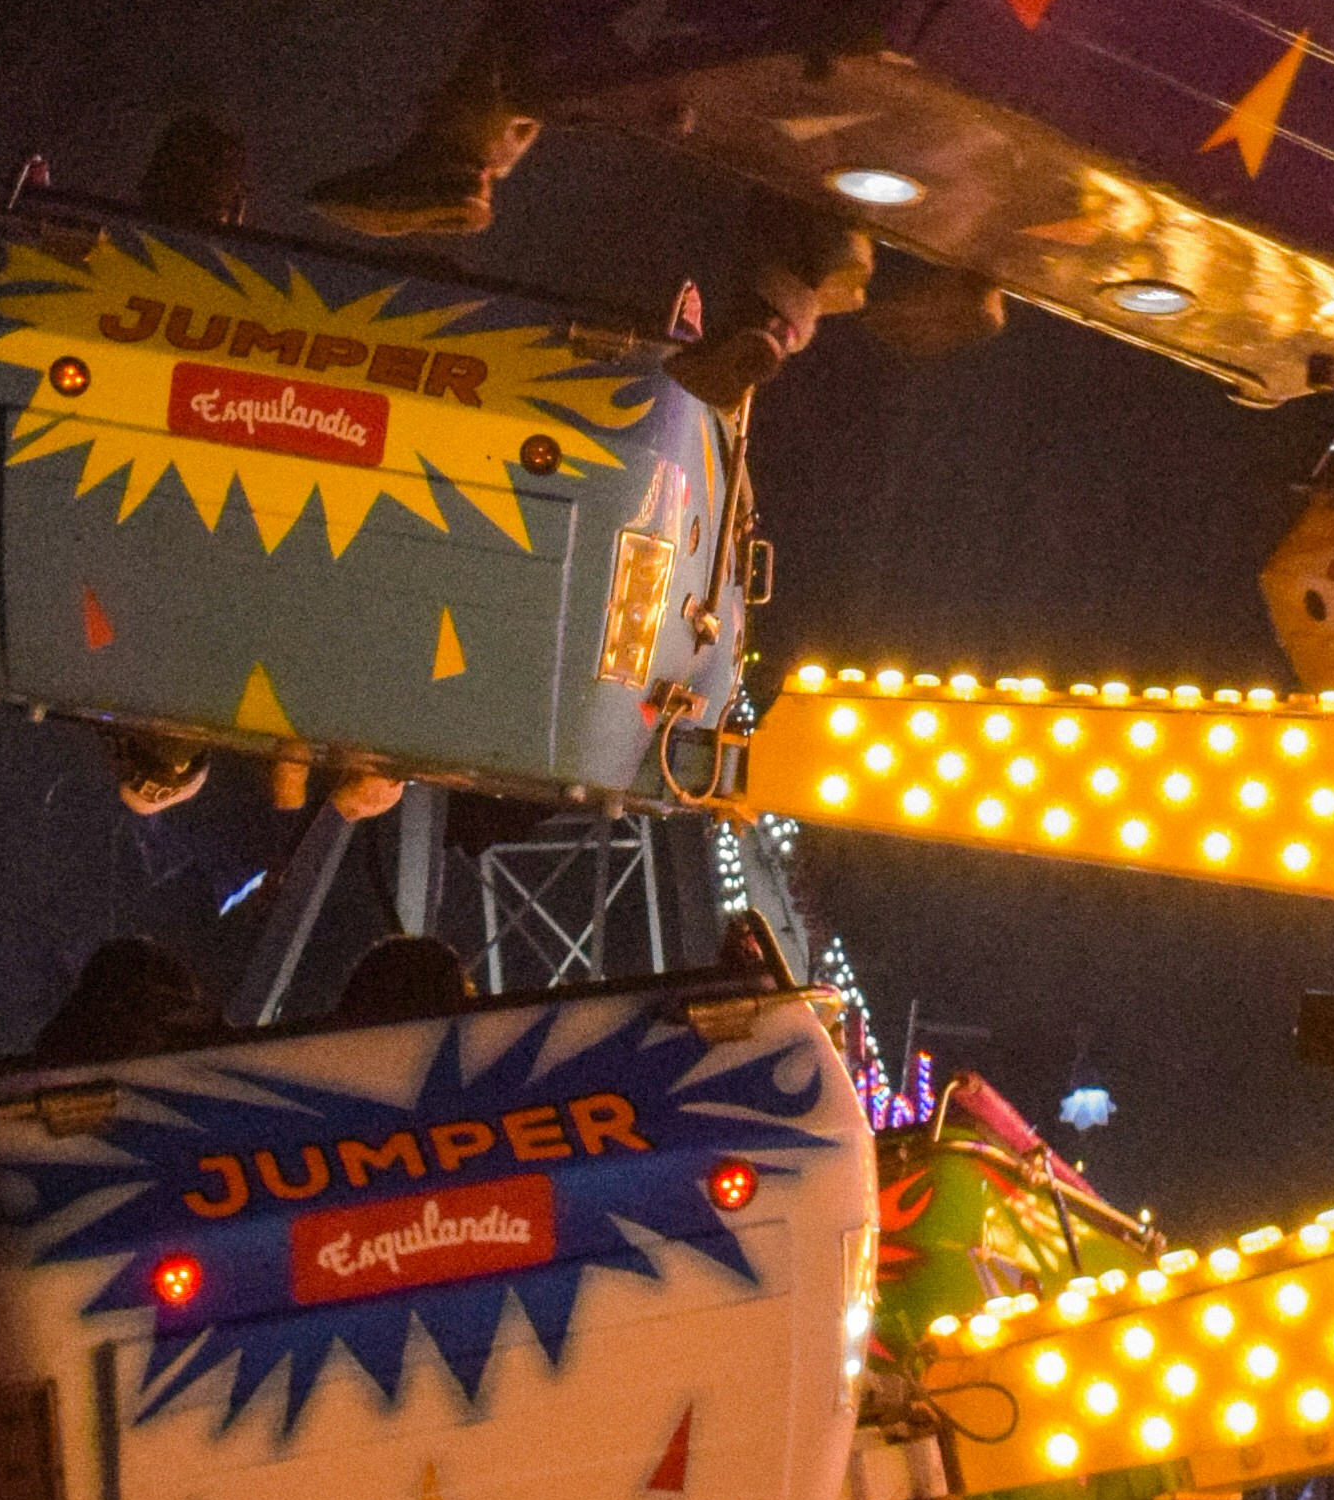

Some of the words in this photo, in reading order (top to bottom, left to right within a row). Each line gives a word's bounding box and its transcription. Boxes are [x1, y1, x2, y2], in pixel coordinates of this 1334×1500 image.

[98, 295, 490, 407] JUMPER
[191, 384, 367, 447] Esquilandia
[182, 1091, 655, 1219] JUMPER
[317, 1200, 531, 1278] Esquilandia
